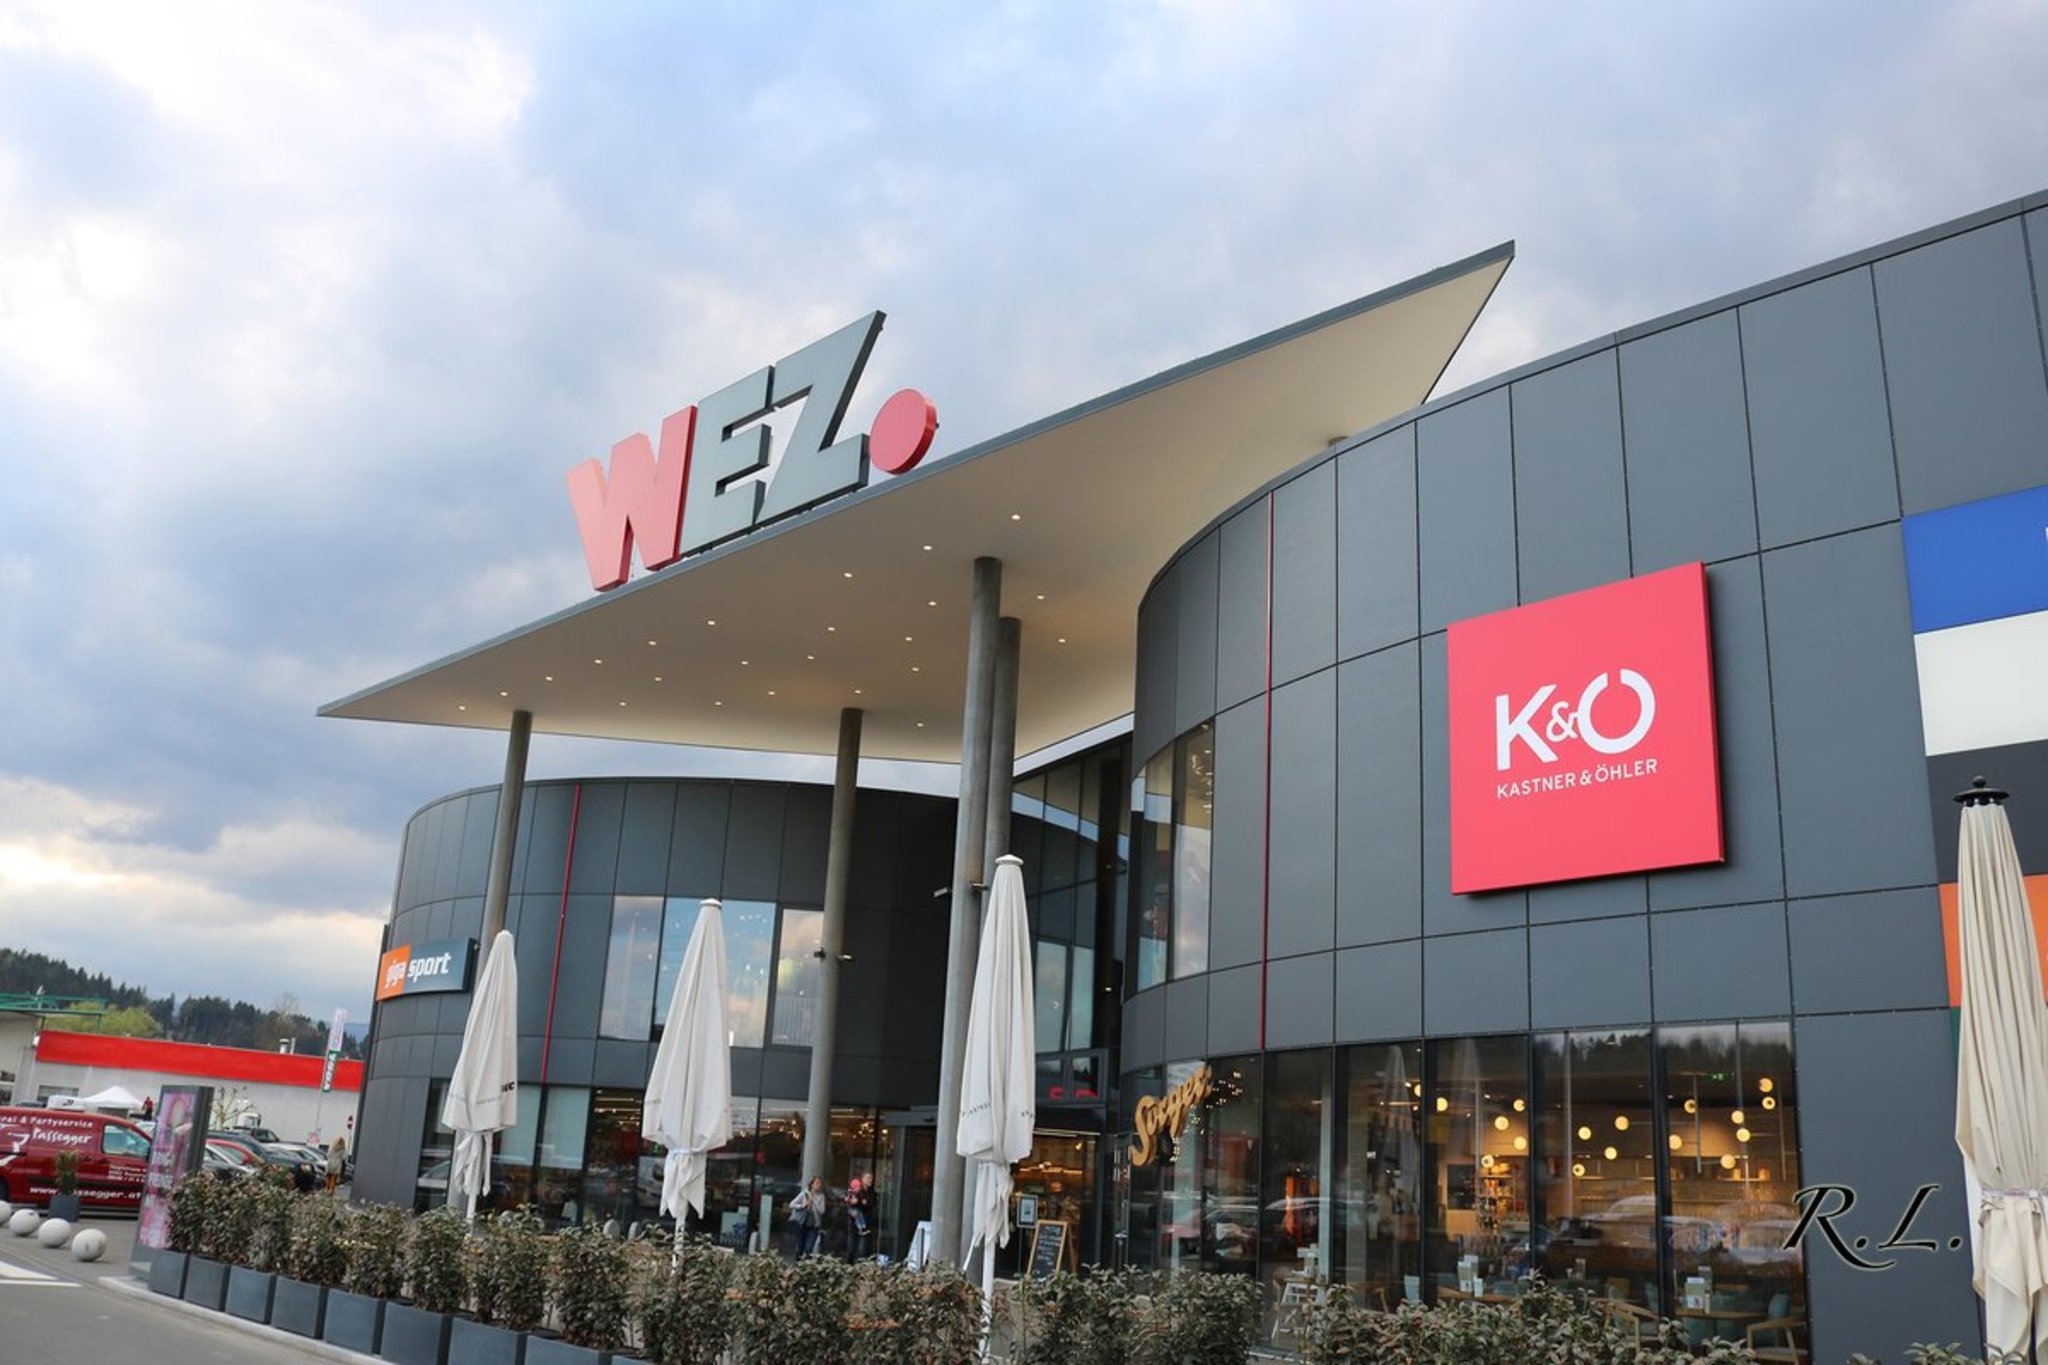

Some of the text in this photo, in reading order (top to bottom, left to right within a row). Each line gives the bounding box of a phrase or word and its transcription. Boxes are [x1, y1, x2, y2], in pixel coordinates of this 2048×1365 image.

[1496, 668, 1656, 771] K&O
[1497, 758, 1658, 799] KASTNER & ÖHLER
[30, 1116, 94, 1129] Partyservice
